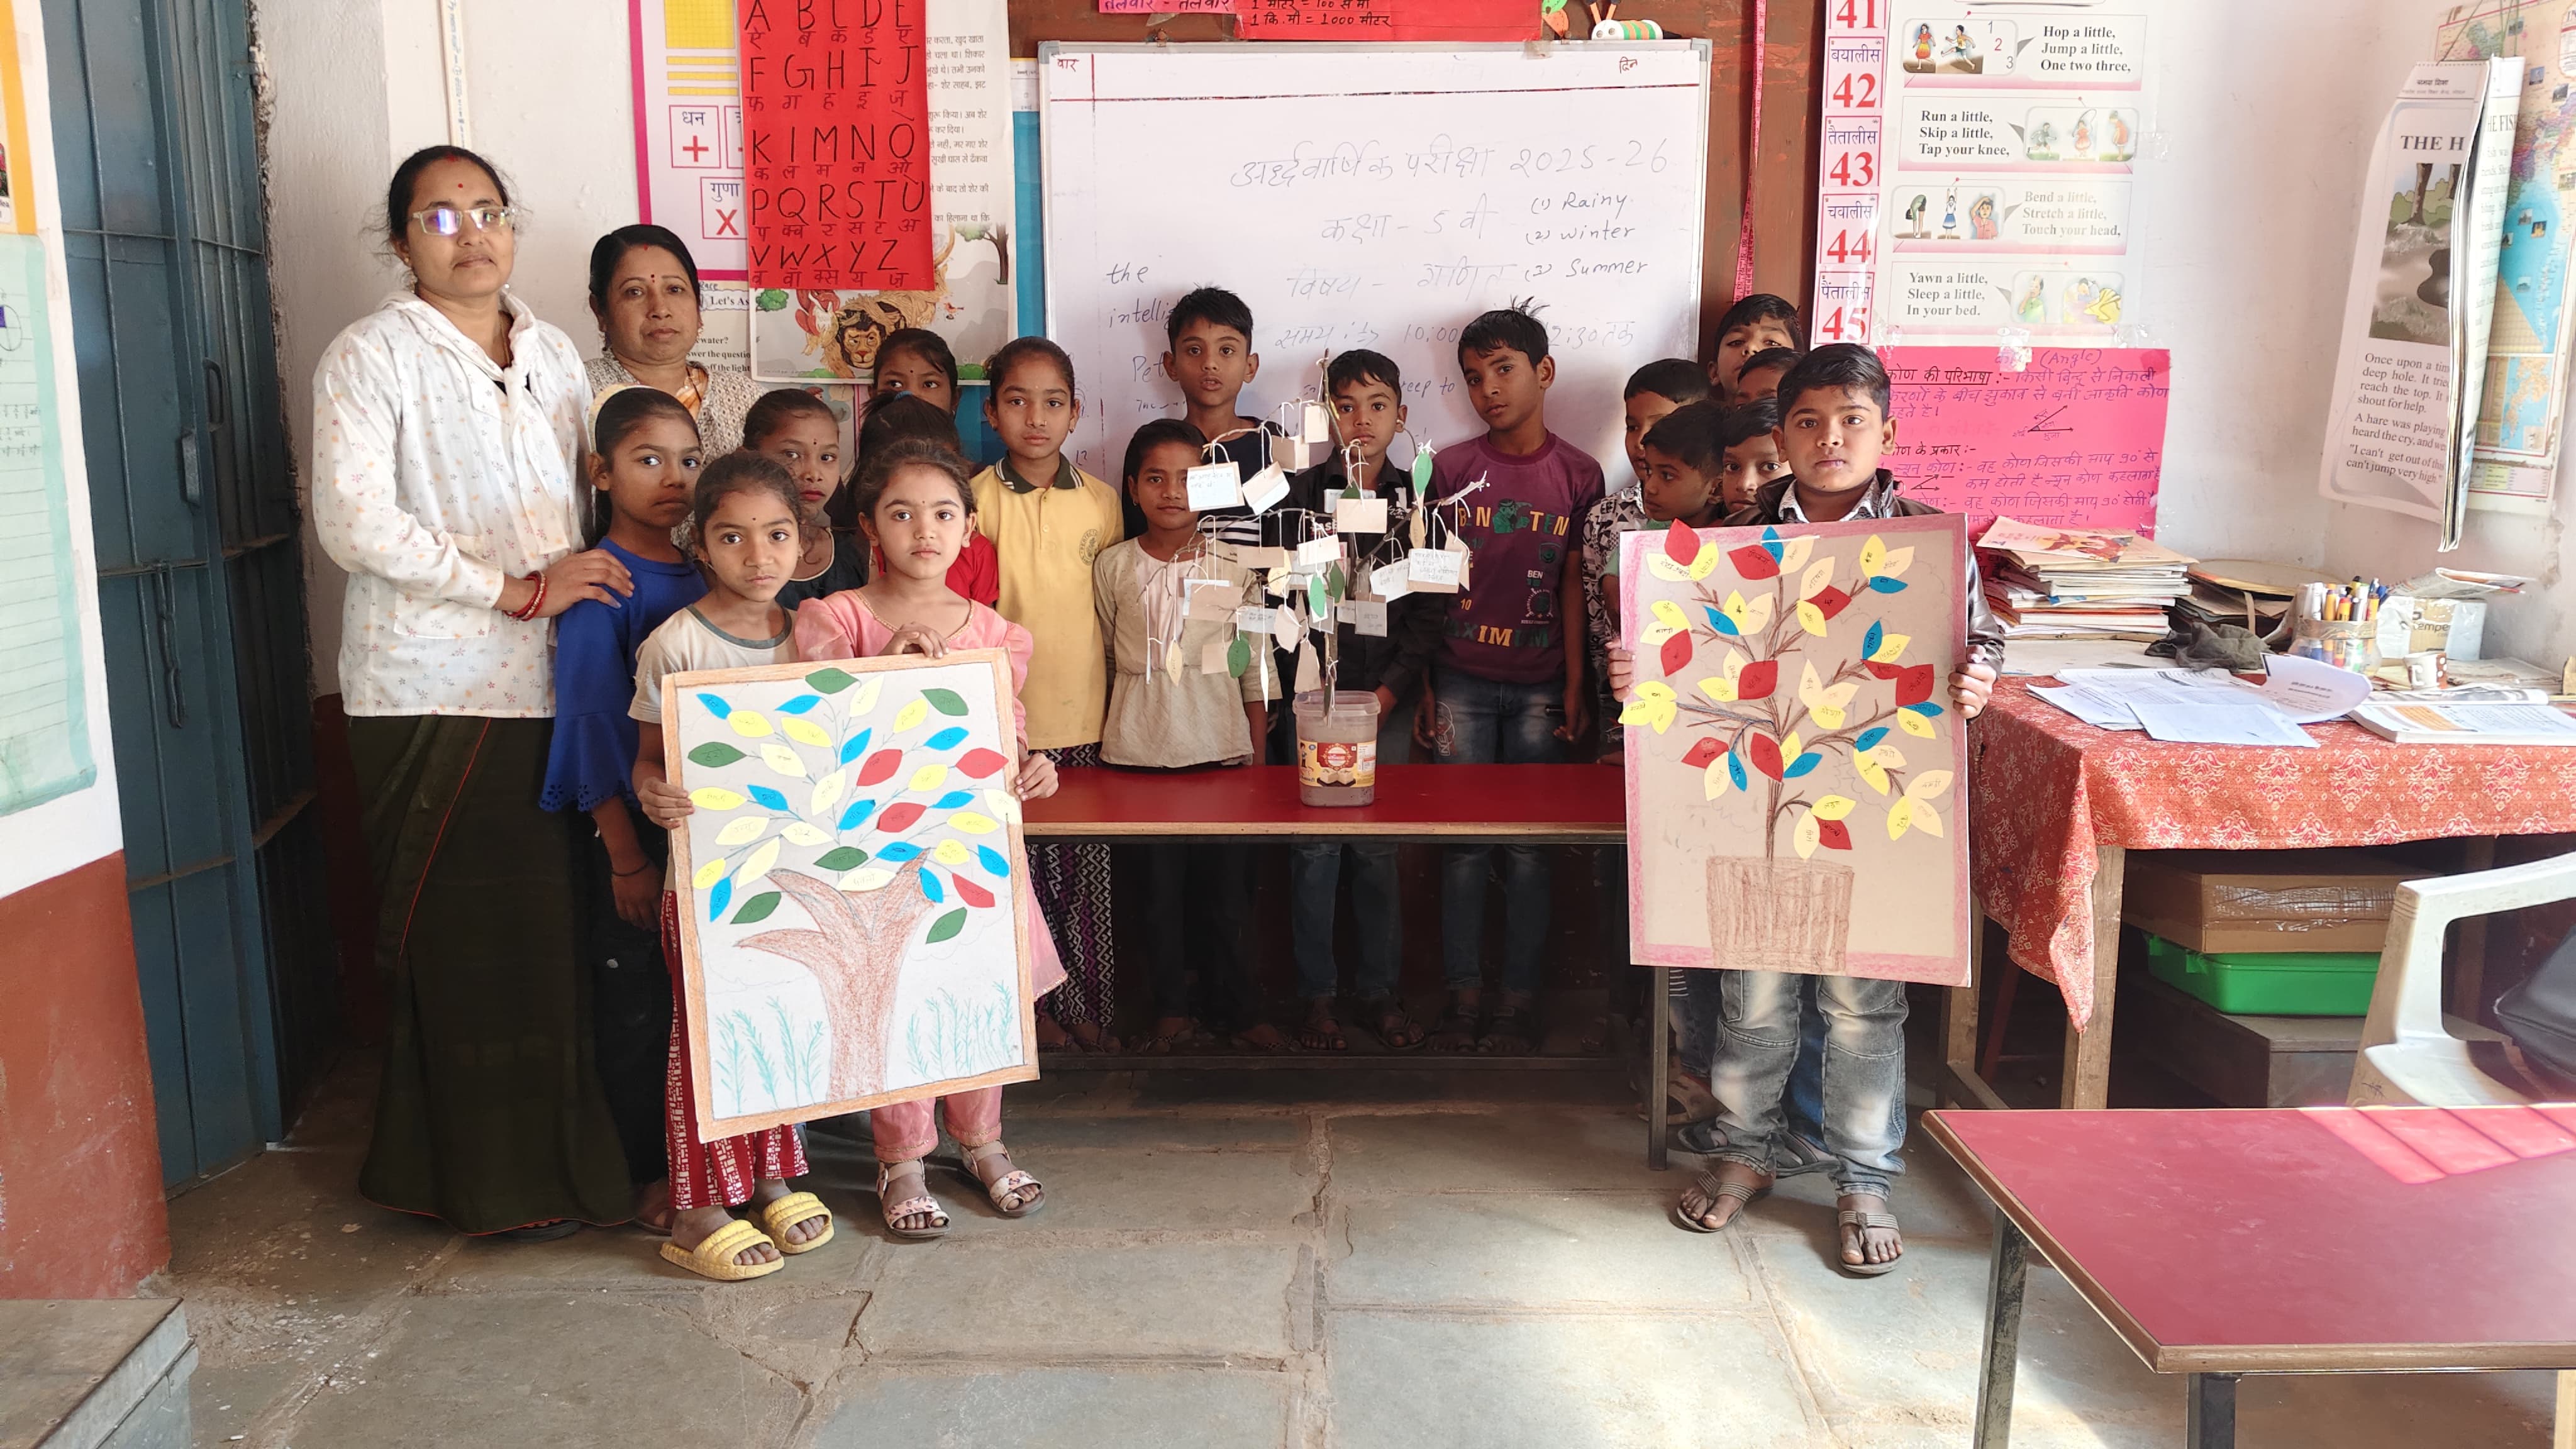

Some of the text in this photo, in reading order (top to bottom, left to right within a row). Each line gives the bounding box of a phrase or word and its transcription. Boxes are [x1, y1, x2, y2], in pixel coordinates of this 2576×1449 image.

[1250, 16, 1259, 26] 1
[1358, 14, 1392, 27] मीटर
[1836, 0, 1879, 28] 41
[1988, 20, 1994, 34] 1
[2043, 26, 2116, 40] Hop a little,
[955, 35, 967, 46] खुद
[969, 35, 984, 43] खाता
[1994, 38, 2002, 51] 2
[935, 50, 948, 58] चला
[965, 48, 985, 58] शिकार
[1831, 44, 1882, 63] बयालीस
[2041, 43, 2123, 57] Jump a little,
[751, 45, 918, 92] F G H I J
[1057, 57, 1080, 72] वार
[1619, 55, 1639, 74] दिन
[2006, 56, 2014, 69] 3
[2041, 59, 2131, 73] One two three,
[941, 79, 950, 89] शेर
[1833, 73, 1877, 108] 42
[682, 111, 706, 126] धन
[1921, 111, 1946, 121] Run
[1962, 111, 1993, 123] little,
[1919, 127, 1947, 141] Skip
[1962, 128, 1993, 140] little,
[753, 130, 772, 165] K
[814, 125, 837, 162] M
[852, 125, 875, 162] N
[978, 138, 988, 148] शेर
[1919, 143, 2009, 158] Tap your knee,
[2401, 136, 2465, 150] THE H
[1406, 133, 1495, 177] परीक्षा
[1829, 152, 1874, 186] 43
[710, 182, 740, 202] गुणा
[969, 183, 977, 192] शेर
[752, 180, 924, 225] P Q R S T U
[1562, 192, 1628, 219] Rainy
[1828, 201, 1874, 219] चवालीस
[1827, 229, 1871, 263] 44
[1106, 263, 1148, 285] the
[1566, 258, 1648, 277] Summer
[1909, 272, 1943, 283] Yawn
[1957, 272, 1988, 285] little,
[711, 297, 735, 305] Let's
[1907, 288, 1940, 302] Sleep
[1954, 289, 1985, 301] little,
[1907, 304, 1980, 318] In your bed.
[1822, 306, 1867, 341] 45
[2365, 353, 2392, 365] Once
[2397, 358, 2422, 369] upon
[1924, 365, 1940, 382] की
[1945, 367, 1993, 384] परिभाषा
[2363, 367, 2429, 384] deep hole. It
[2360, 382, 2431, 401] reach the top.
[2358, 394, 2426, 414] shout for help.
[2355, 413, 2445, 438] A hare was playing
[2352, 426, 2380, 438] heard
[2382, 430, 2396, 441] the
[2417, 439, 2433, 448] and
[1929, 445, 1961, 457] प्रकार
[2360, 448, 2384, 458] can't
[2388, 453, 2403, 462] get
[2406, 456, 2421, 465] out
[2422, 458, 2432, 467] of
[1927, 459, 1956, 473] कोण
[2002, 453, 2031, 469] कोण
[2035, 450, 2083, 467] जिसकी
[2346, 459, 2418, 480] can't jump very
[1530, 510, 1570, 536] TEN
[1527, 570, 1543, 579] BEN
[1460, 599, 1472, 611] 10
